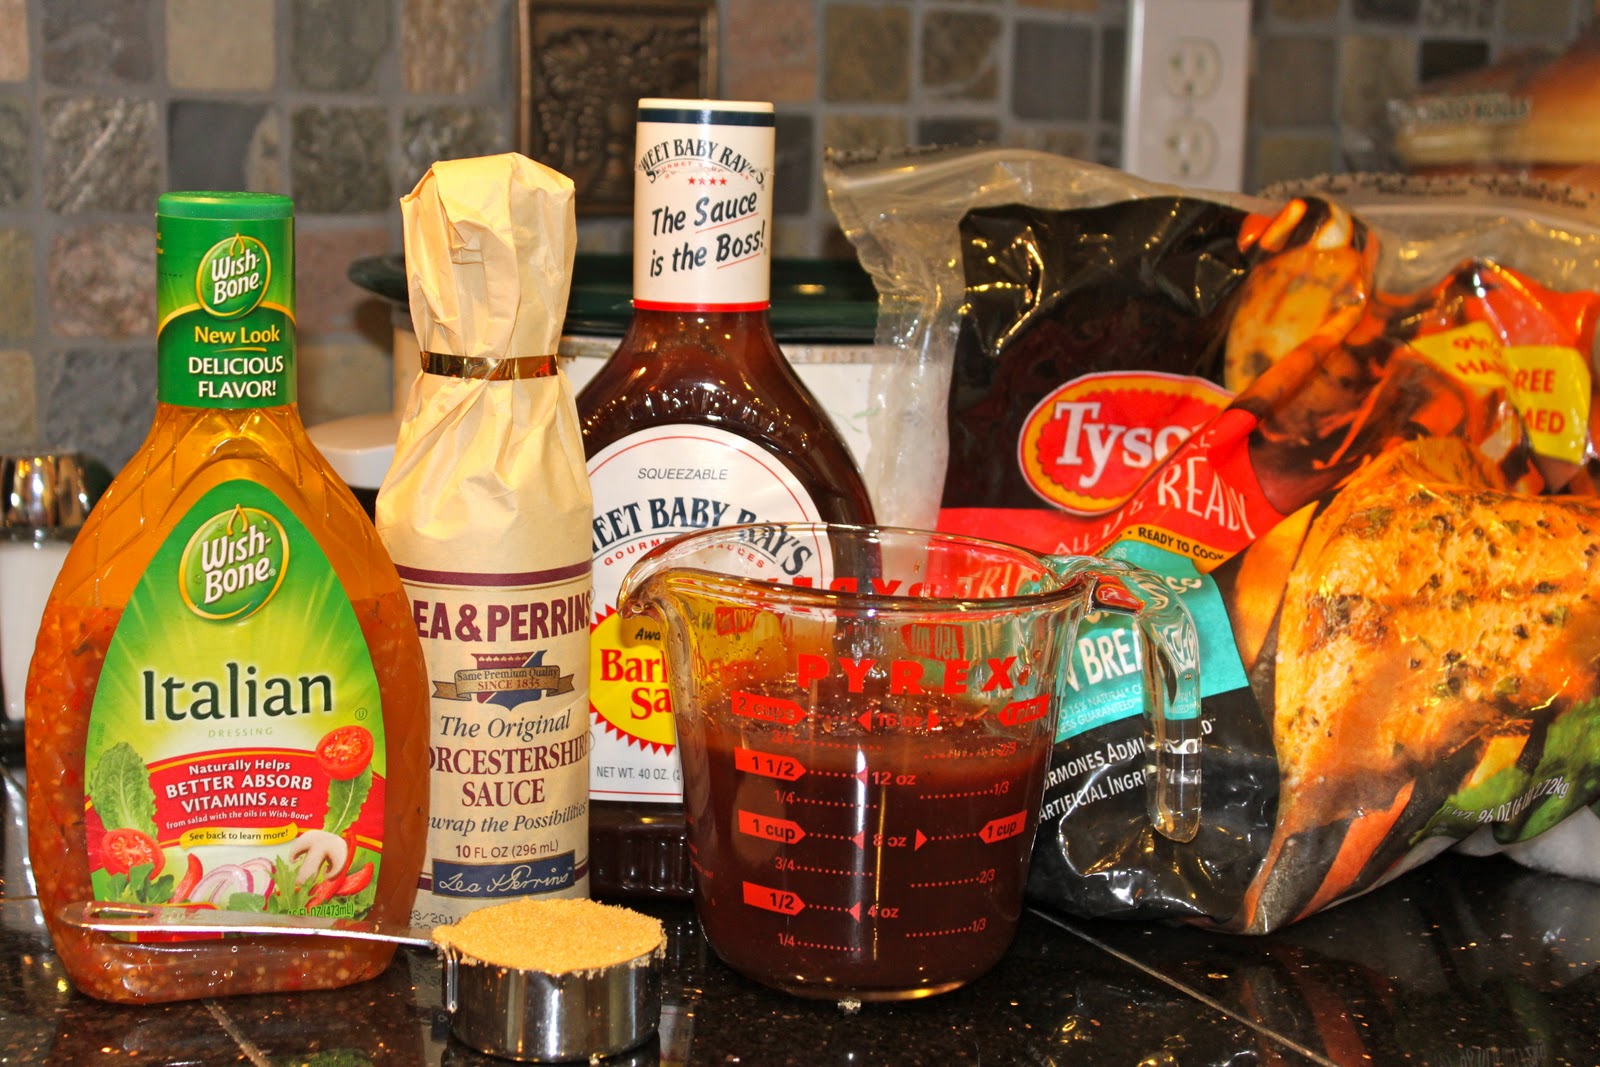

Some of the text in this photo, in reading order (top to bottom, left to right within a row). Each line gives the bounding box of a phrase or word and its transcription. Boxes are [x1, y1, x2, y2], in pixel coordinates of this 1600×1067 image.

[673, 138, 718, 160] BABY
[652, 191, 758, 236] The Sauce
[650, 219, 766, 278] is the Boss!
[211, 248, 260, 281] Wish-
[213, 271, 260, 305] Bone
[194, 324, 280, 344] New Look
[188, 355, 284, 375] DELICIOUS
[198, 379, 277, 399] FLAVOR!
[1512, 368, 1557, 394] REE
[1054, 401, 1192, 489] Tyso
[637, 467, 728, 481] SQUEEZABLE
[592, 501, 641, 552] EET
[648, 496, 731, 529] BABY
[201, 525, 272, 573] Wish-
[1138, 526, 1174, 549] READY
[1176, 541, 1190, 553] TO
[604, 537, 672, 566] GOURM
[204, 557, 270, 604] Bone
[457, 666, 559, 681] Same Premium Quality
[797, 653, 1017, 695] PYREX
[142, 662, 332, 722] Italian
[478, 680, 512, 691] SINCE
[738, 697, 795, 720] 2 cups
[440, 709, 571, 742] The Original
[877, 712, 897, 727] 16
[208, 727, 273, 739] DRESSING
[771, 729, 794, 746] 3/4
[188, 759, 291, 776] Naturally Helps
[596, 766, 616, 778] NET
[617, 767, 636, 779] WT.
[638, 768, 651, 780] 40
[653, 768, 670, 781] OZ.
[752, 756, 795, 777] 1 1/2
[1044, 751, 1105, 791] ORMONES
[165, 774, 313, 799] BETTER ABSORB
[872, 771, 917, 786] 12 oz
[994, 780, 1010, 796] 1/3
[181, 792, 298, 813] VITAMINS A & E
[461, 777, 546, 808] SAUCE
[774, 789, 794, 805] 1/4
[166, 820, 186, 830] from
[187, 814, 208, 825] salad
[209, 812, 227, 821] with
[229, 810, 242, 819] the
[243, 809, 258, 818] oils
[259, 809, 267, 818] in
[428, 815, 476, 836] wrap
[480, 817, 508, 833] the
[987, 820, 1017, 839] 1 cup
[189, 829, 289, 841] See back to learn more!
[753, 818, 796, 842] 1 cup
[873, 833, 907, 847] 8 oz
[455, 839, 559, 859] 10 FL OZ (296 mL)
[775, 857, 795, 871] 3/4
[979, 868, 995, 884] 2/3
[769, 892, 795, 910] 1/2
[867, 904, 899, 919] 4 oz
[972, 917, 987, 933] 1/3
[778, 933, 795, 948] 1/4
